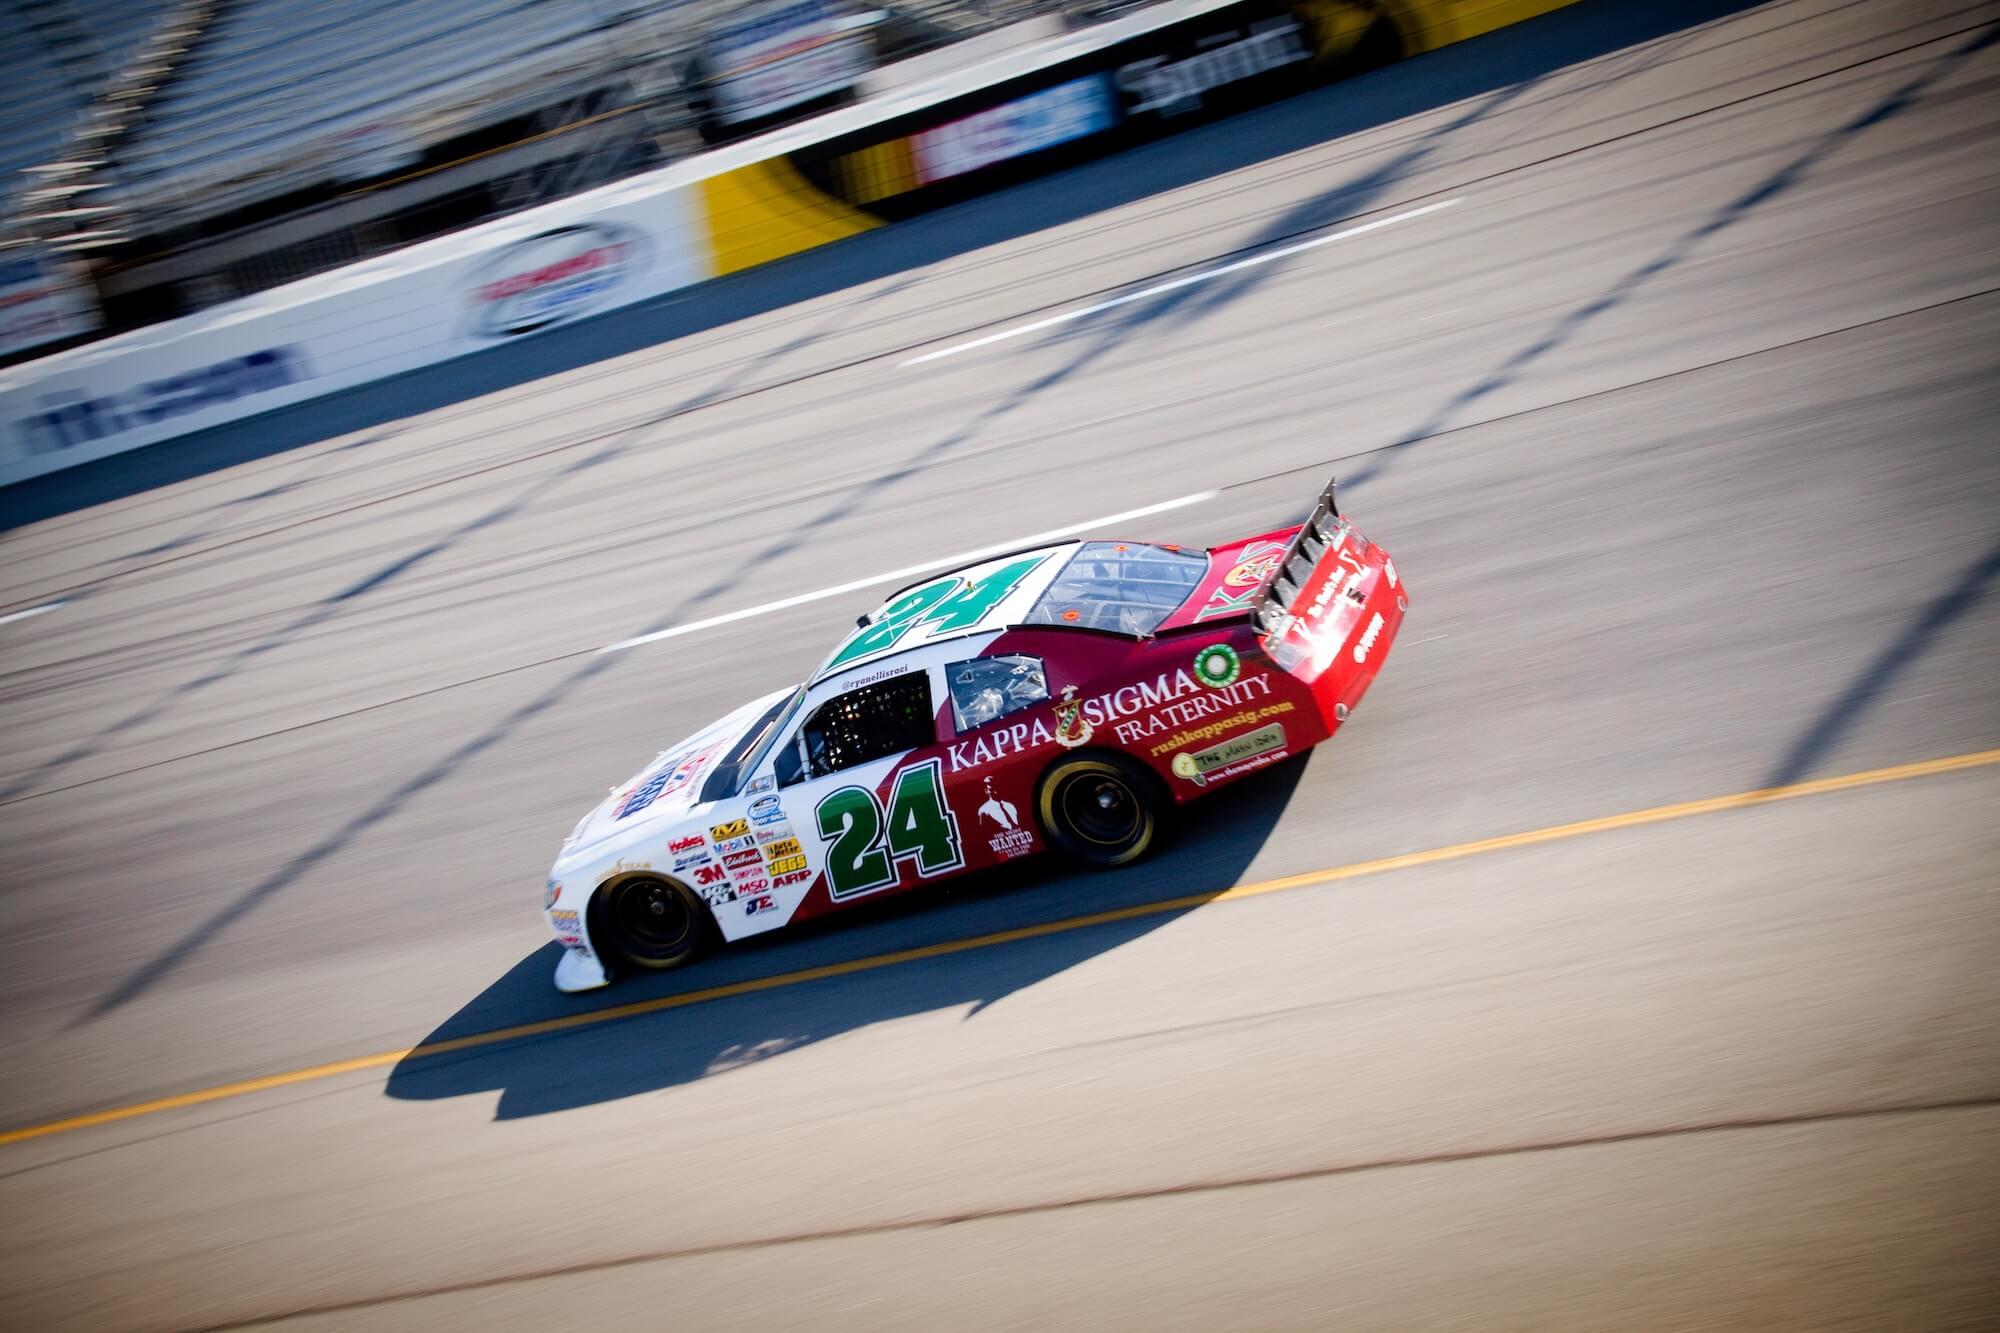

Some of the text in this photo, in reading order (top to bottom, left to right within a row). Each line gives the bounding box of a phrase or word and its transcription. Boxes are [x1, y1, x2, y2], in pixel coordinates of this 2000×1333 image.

[817, 552, 1058, 679] 24
[1083, 668, 1202, 727] SIGMA
[1114, 673, 1272, 744] FRATERNITY
[947, 717, 1056, 773] KAPPA
[1150, 700, 1295, 757] rushkappasig.com
[814, 756, 966, 903] 24
[988, 831, 1033, 851] WANTED
[693, 863, 726, 884] 3M
[738, 879, 768, 895] MSD
[766, 854, 807, 877] JEGS
[772, 870, 812, 889] ARP
